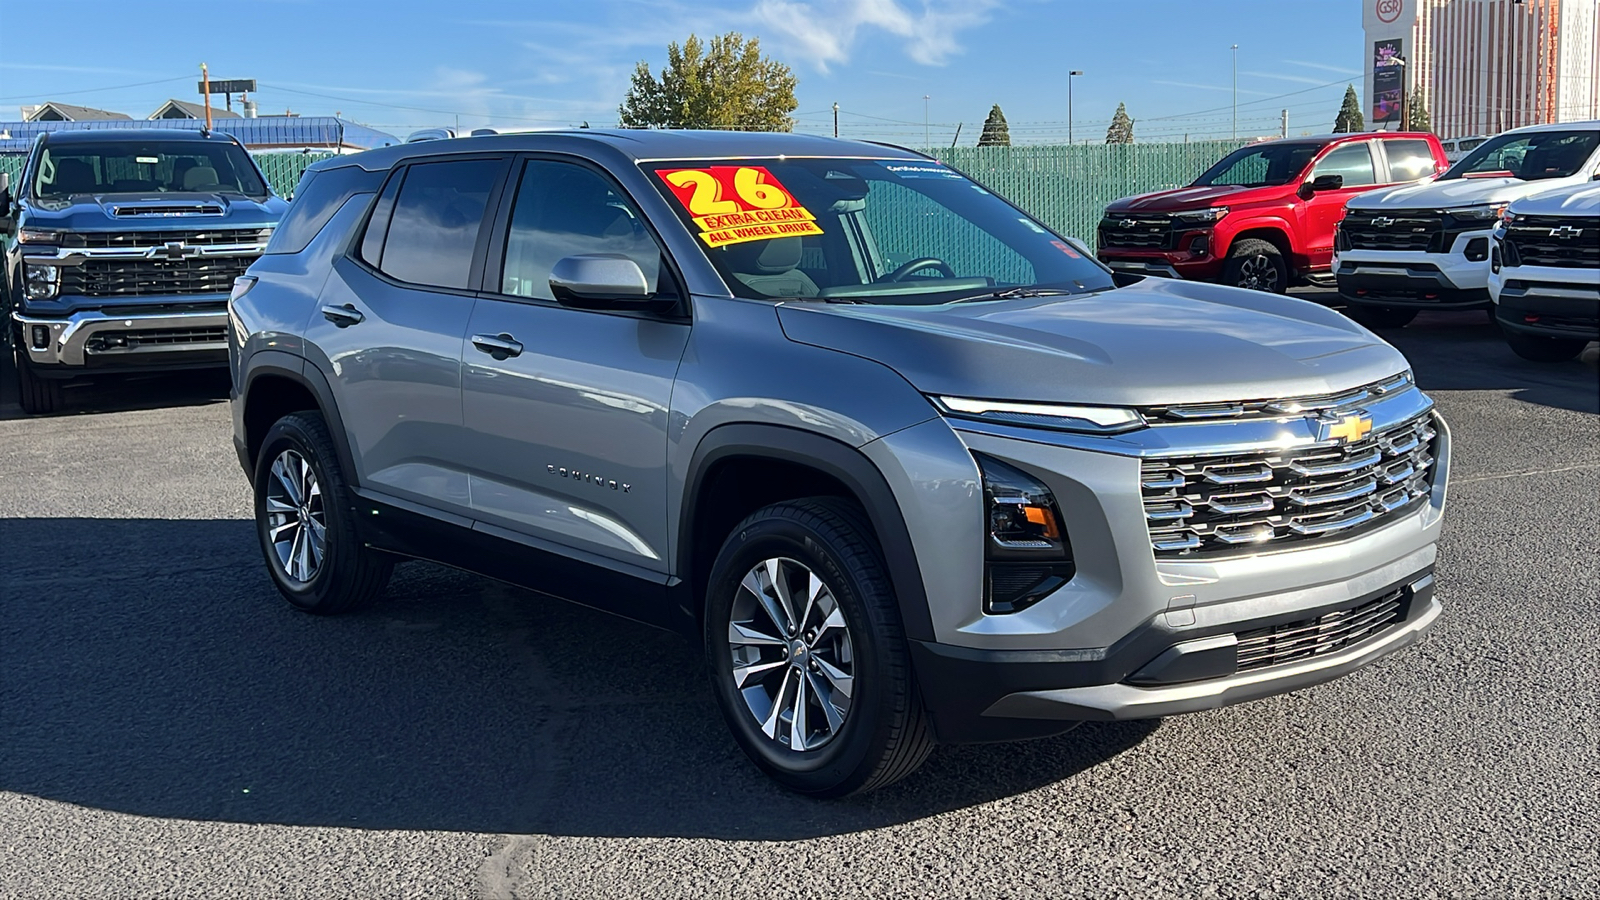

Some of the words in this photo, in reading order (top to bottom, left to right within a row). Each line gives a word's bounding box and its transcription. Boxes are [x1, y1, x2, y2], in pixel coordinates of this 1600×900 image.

[1380, 0, 1398, 13] GSR
[666, 167, 792, 216] 26
[703, 212, 757, 229] EXTRA
[756, 208, 805, 223] CLEAN
[708, 231, 735, 244] ALL
[733, 224, 777, 239] WHEEL
[778, 221, 815, 234] DRIVE
[546, 464, 632, 494] EQUINOX
